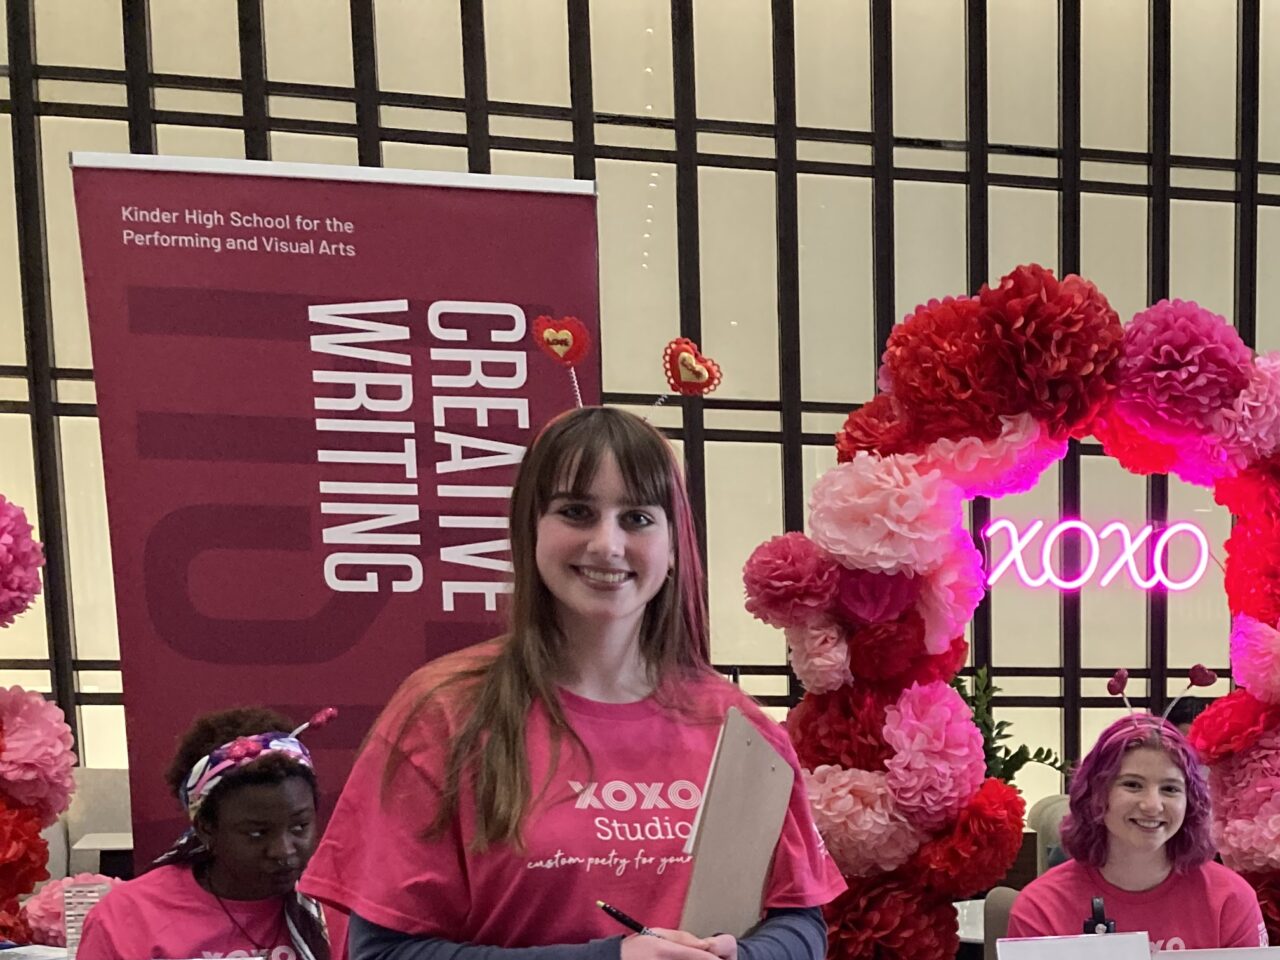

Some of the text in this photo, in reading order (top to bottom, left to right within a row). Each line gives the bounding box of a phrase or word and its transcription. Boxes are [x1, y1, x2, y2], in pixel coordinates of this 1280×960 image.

[121, 206, 354, 233] Kinder High School for the
[122, 229, 356, 257] Performing and Visual Arts
[307, 299, 423, 594] WRITING
[567, 779, 702, 812] XOXO
[594, 816, 694, 841] Studio
[586, 849, 631, 877] poetry
[635, 849, 654, 869] for
